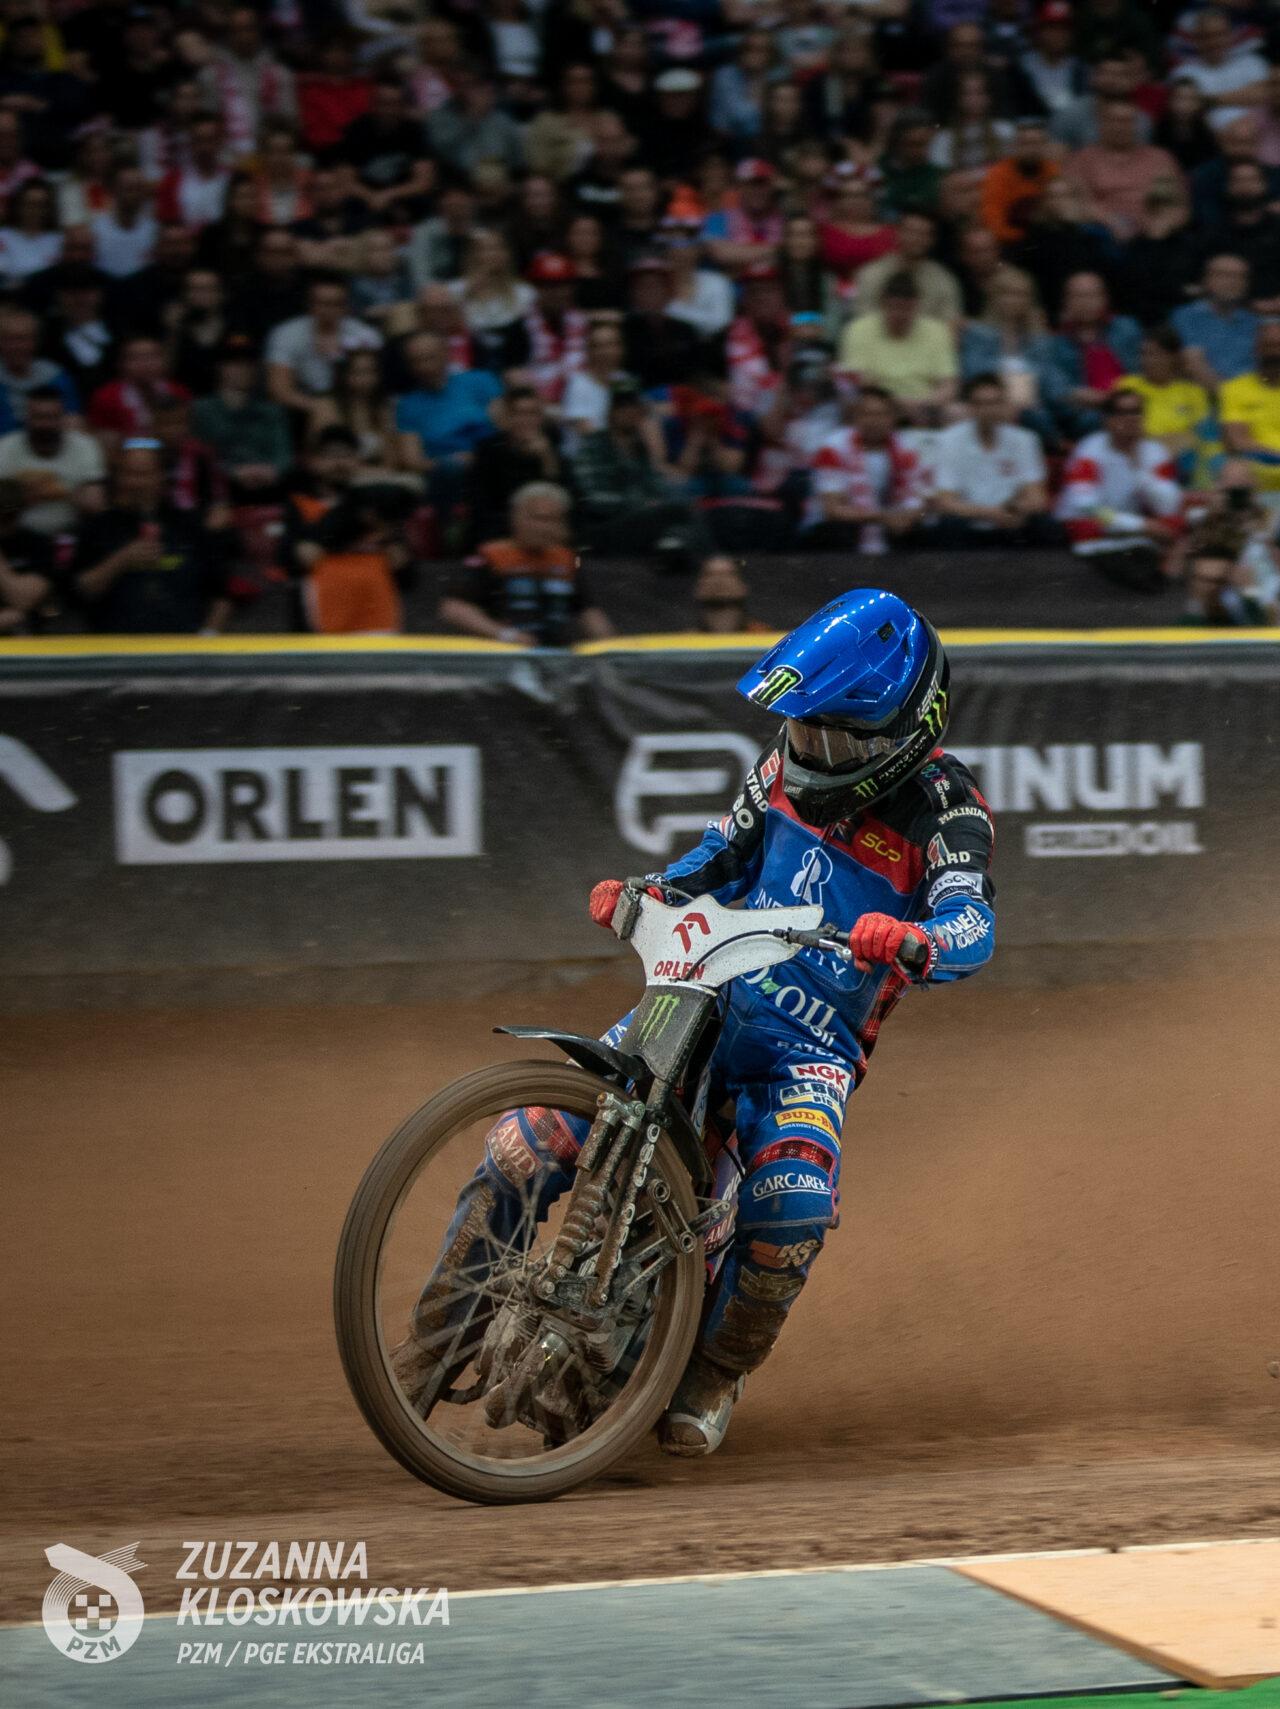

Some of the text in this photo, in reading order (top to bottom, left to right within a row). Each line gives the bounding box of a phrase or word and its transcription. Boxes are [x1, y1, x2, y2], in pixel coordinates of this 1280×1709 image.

[747, 767, 770, 813] TARD
[145, 765, 456, 846] ORLEN
[653, 960, 706, 980] ORLEN
[796, 1065, 847, 1092] NGK
[752, 1172, 832, 1198] GARCAREK
